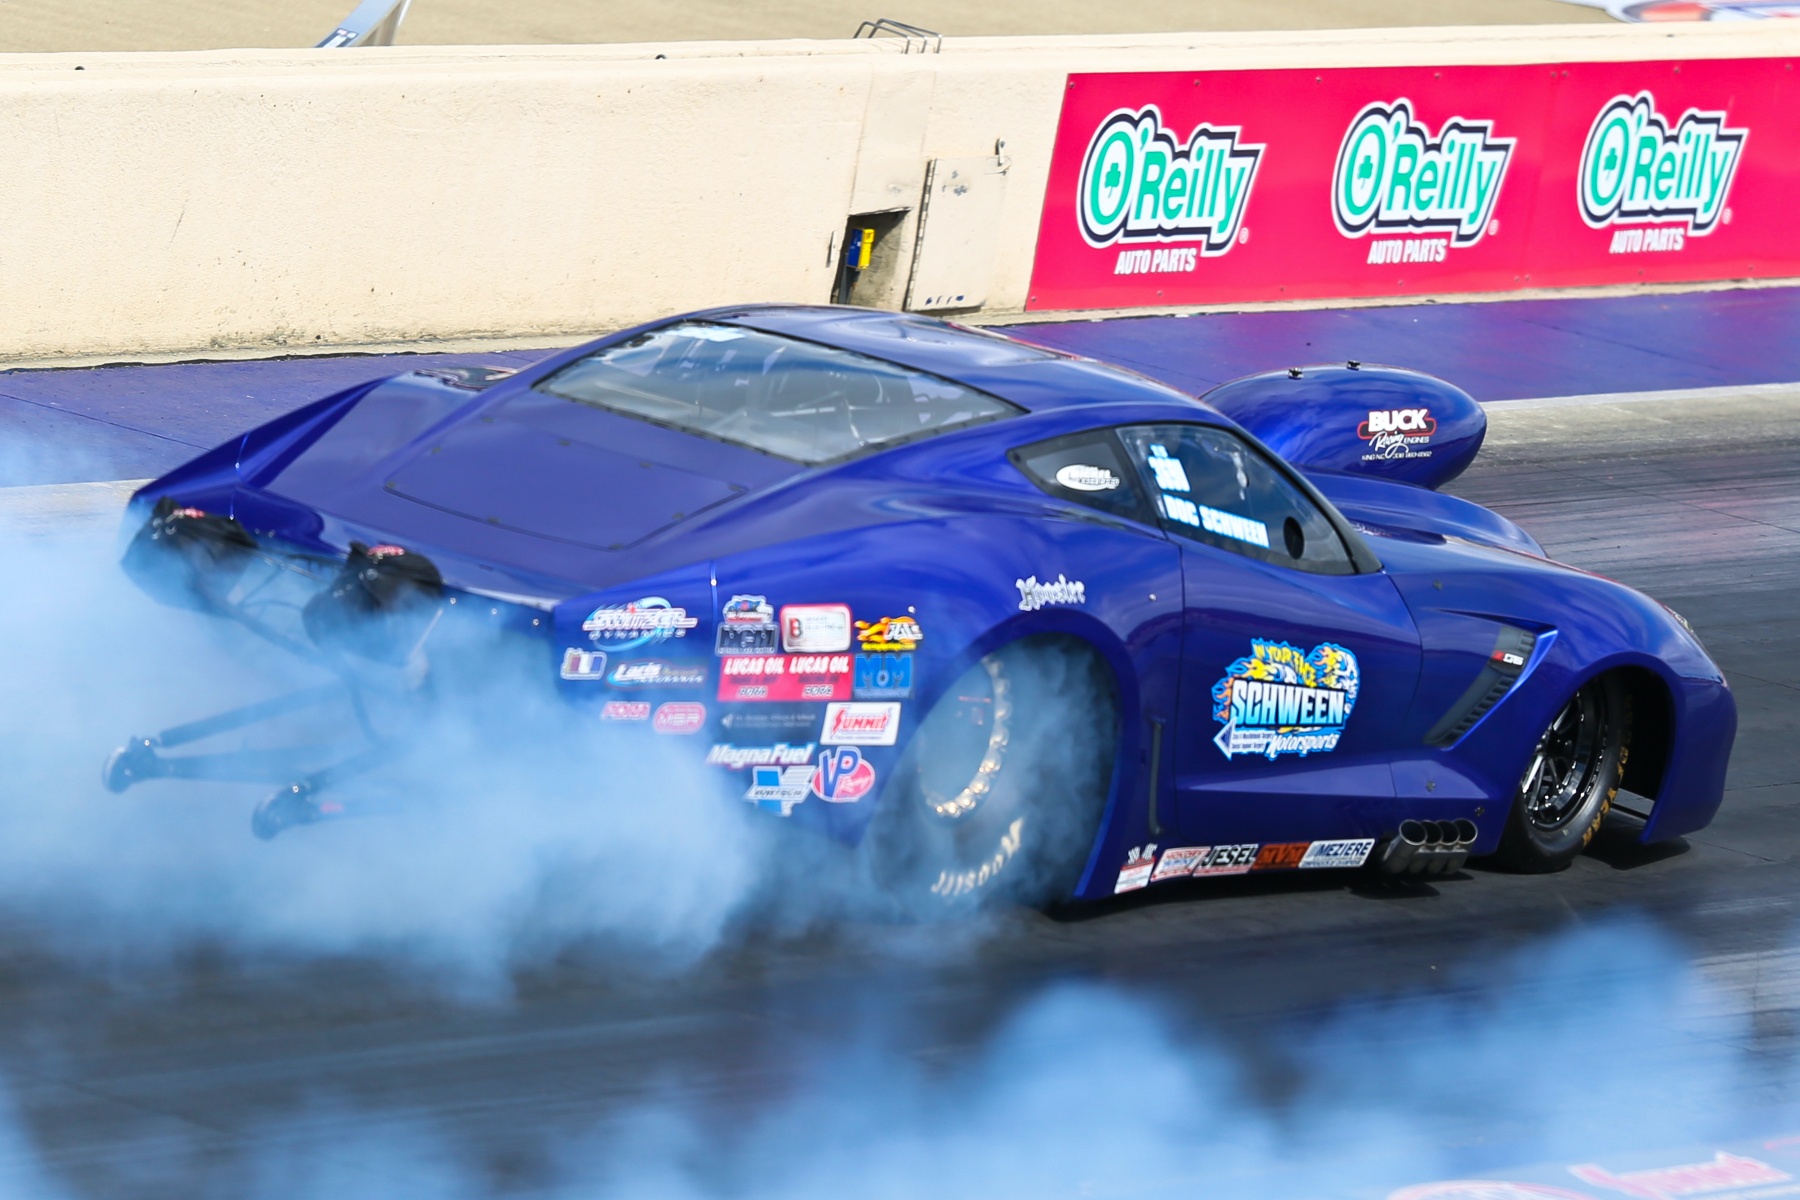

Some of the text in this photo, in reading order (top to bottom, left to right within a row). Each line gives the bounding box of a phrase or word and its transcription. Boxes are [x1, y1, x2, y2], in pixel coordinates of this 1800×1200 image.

[1341, 118, 1500, 228] O'Reilly
[1588, 111, 1732, 216] O'Reilly
[1087, 124, 1249, 236] O'Reilly
[1366, 238, 1448, 265] AUTO PARTS
[1608, 227, 1686, 254] AUTO PARTS
[1113, 247, 1198, 275] AUTO PARTS
[1367, 408, 1428, 432] BUCK
[1198, 504, 1270, 550] SCHWEEN
[723, 657, 786, 676] LUCAS OIL
[788, 655, 850, 675] LUCAS OIL
[1230, 679, 1346, 725] SCHWEEN
[707, 743, 816, 769] MagnaFuel
[1266, 733, 1342, 760] Motorsports
[819, 749, 861, 800] VP
[1203, 844, 1258, 866] JESEL
[1317, 841, 1373, 857] MEZIERE
